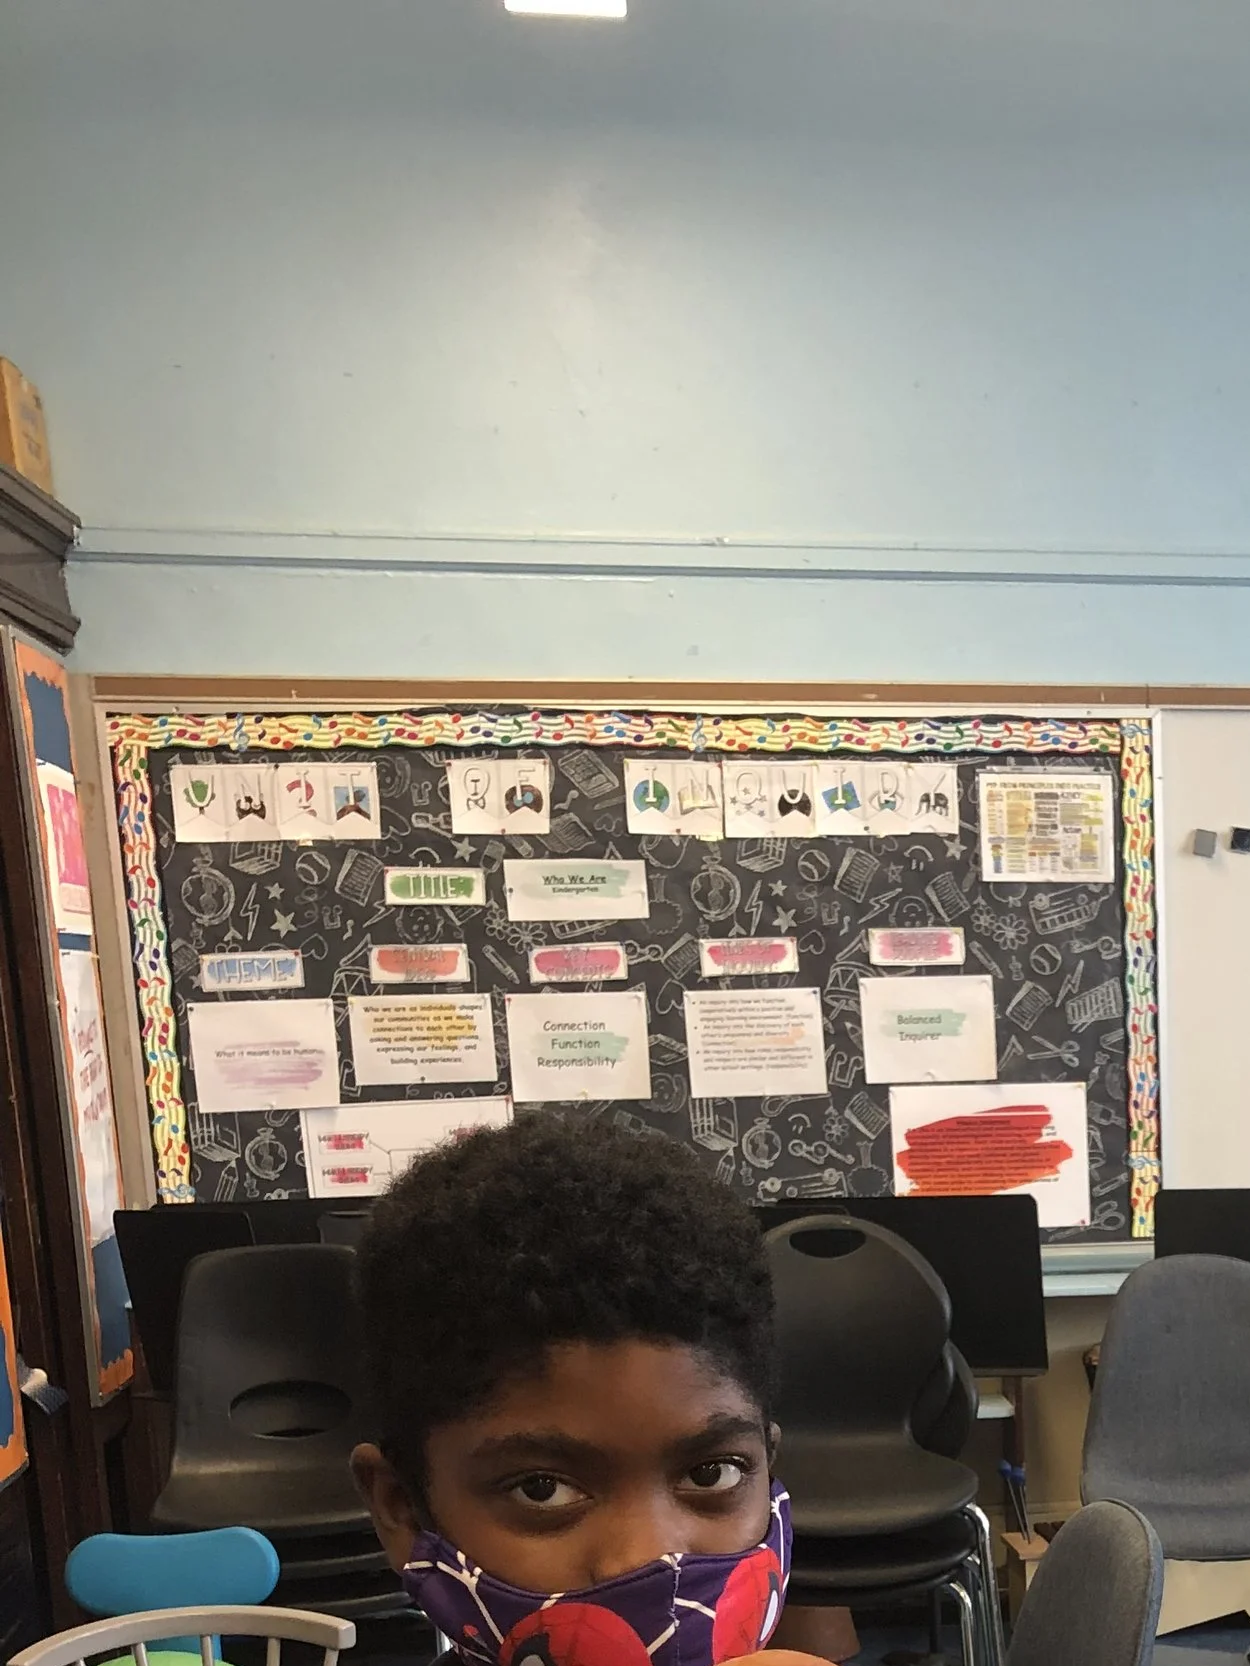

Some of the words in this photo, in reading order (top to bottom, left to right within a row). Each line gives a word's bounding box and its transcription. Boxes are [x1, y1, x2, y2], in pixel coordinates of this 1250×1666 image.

[542, 875, 564, 885] Who
[567, 874, 587, 884] We
[589, 874, 607, 884] Are
[897, 1014, 942, 1025] Balanced
[543, 1020, 606, 1031] Connection
[551, 1038, 601, 1049] Function
[537, 1056, 616, 1070] Responsibility
